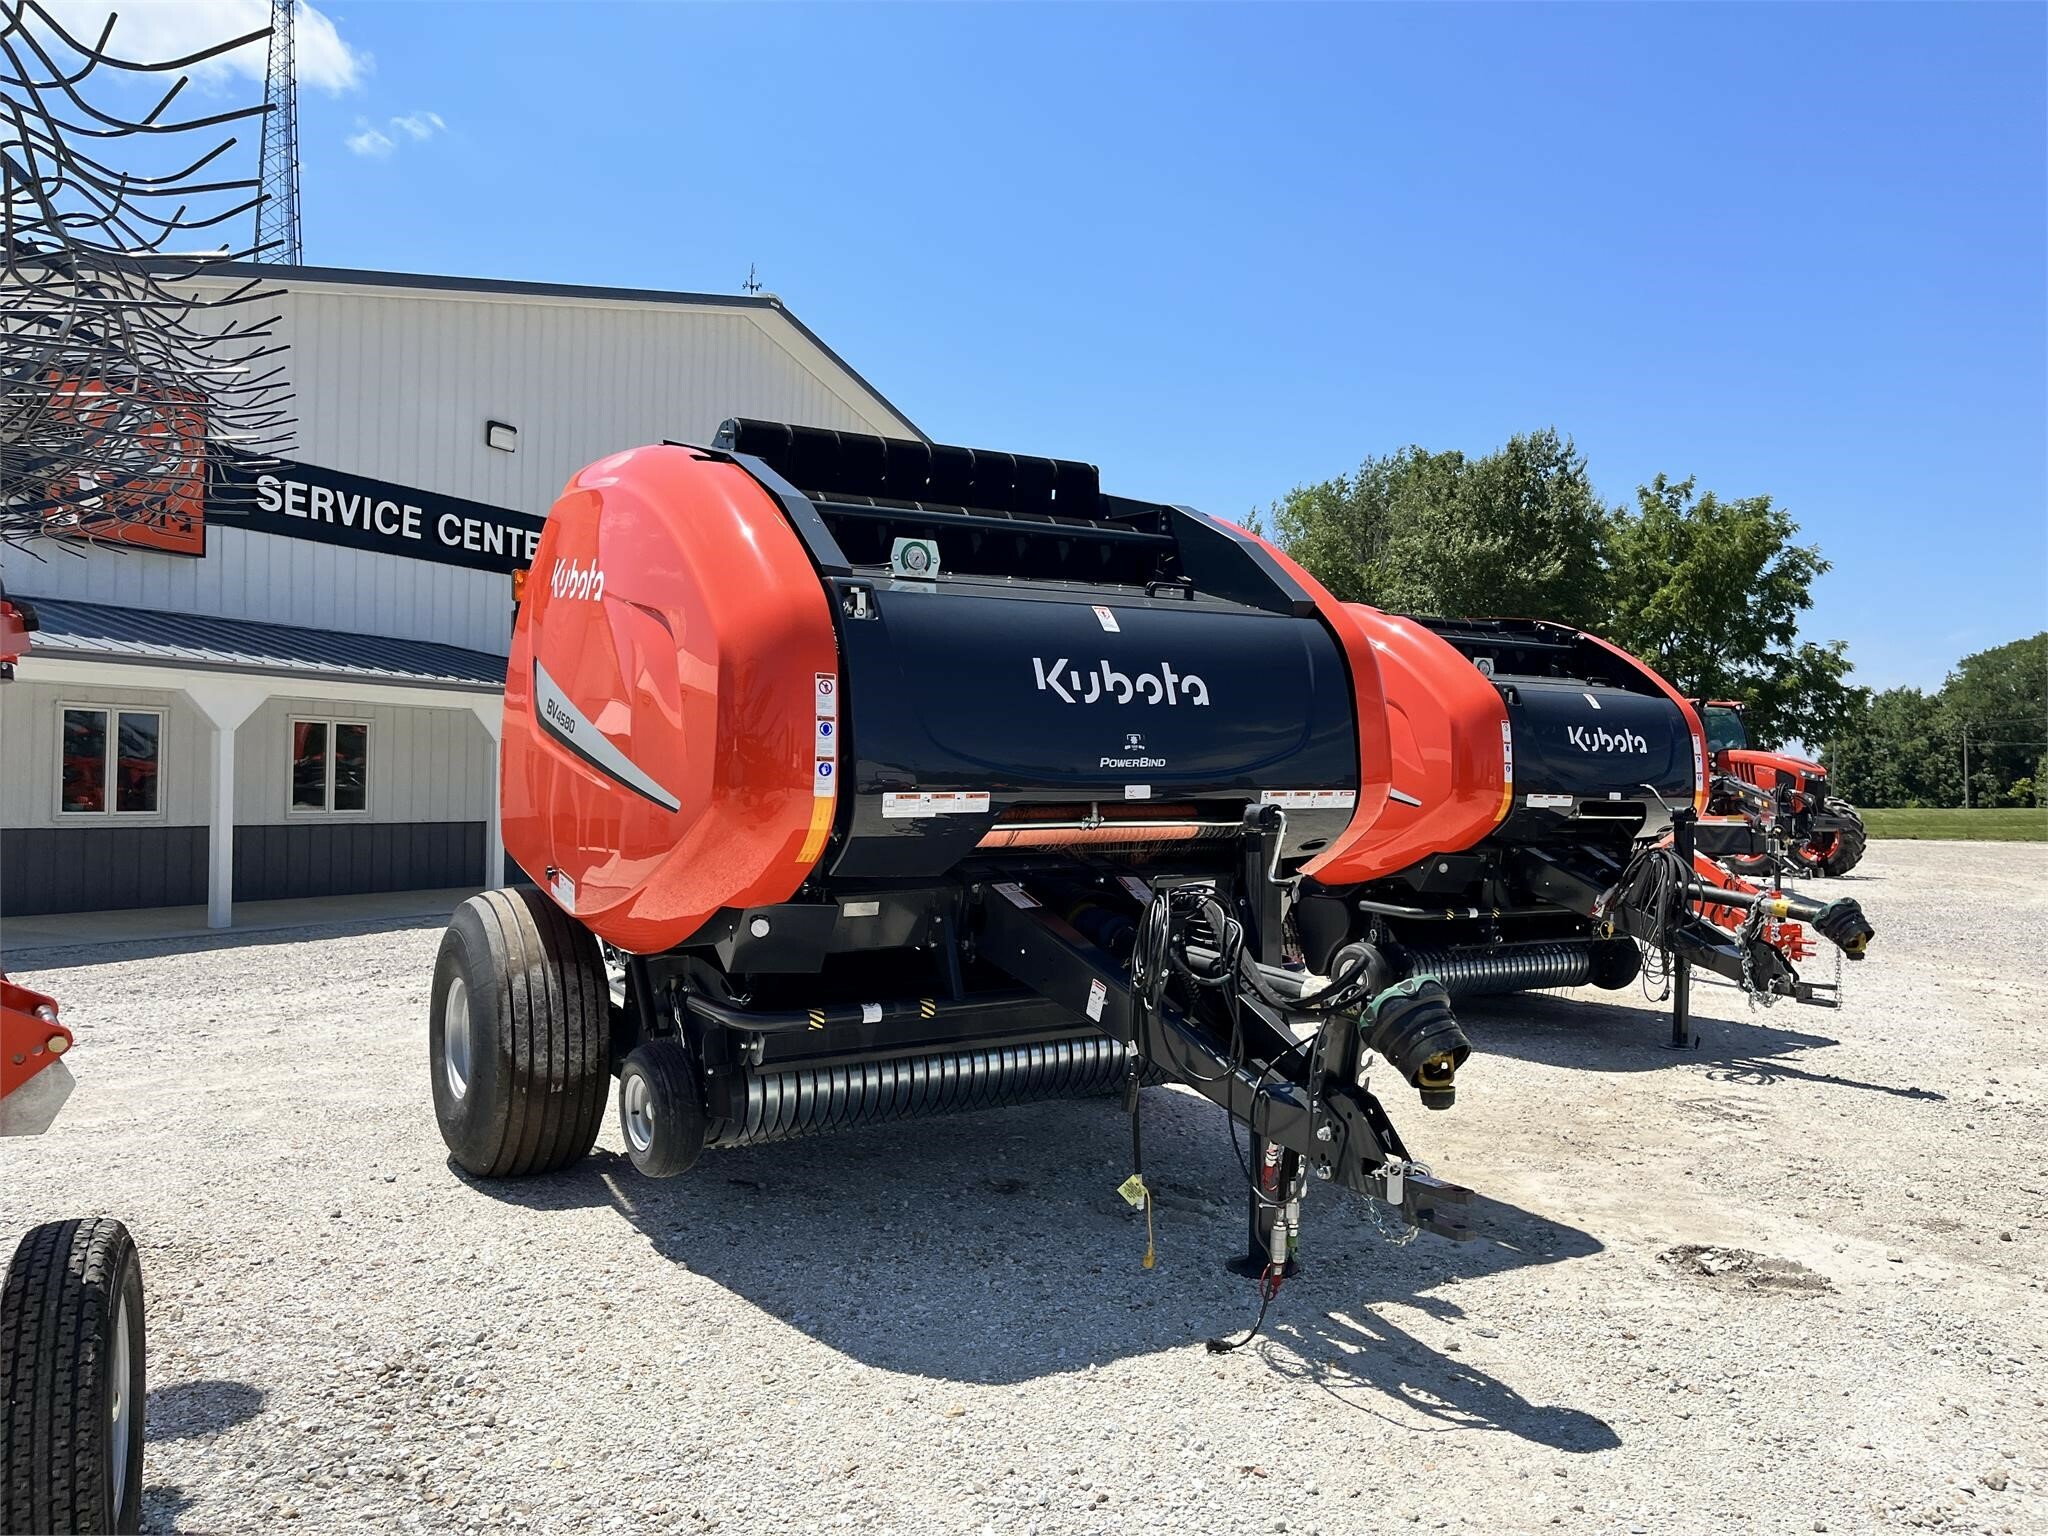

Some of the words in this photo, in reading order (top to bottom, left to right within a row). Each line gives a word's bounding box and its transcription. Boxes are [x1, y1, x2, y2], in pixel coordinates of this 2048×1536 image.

[256, 475, 422, 539] SERVICE
[437, 513, 540, 560] CENTE
[551, 558, 605, 602] Kubota
[1032, 657, 1210, 706] Kubota
[547, 698, 575, 734] BV4580
[1567, 726, 1648, 754] Kubota
